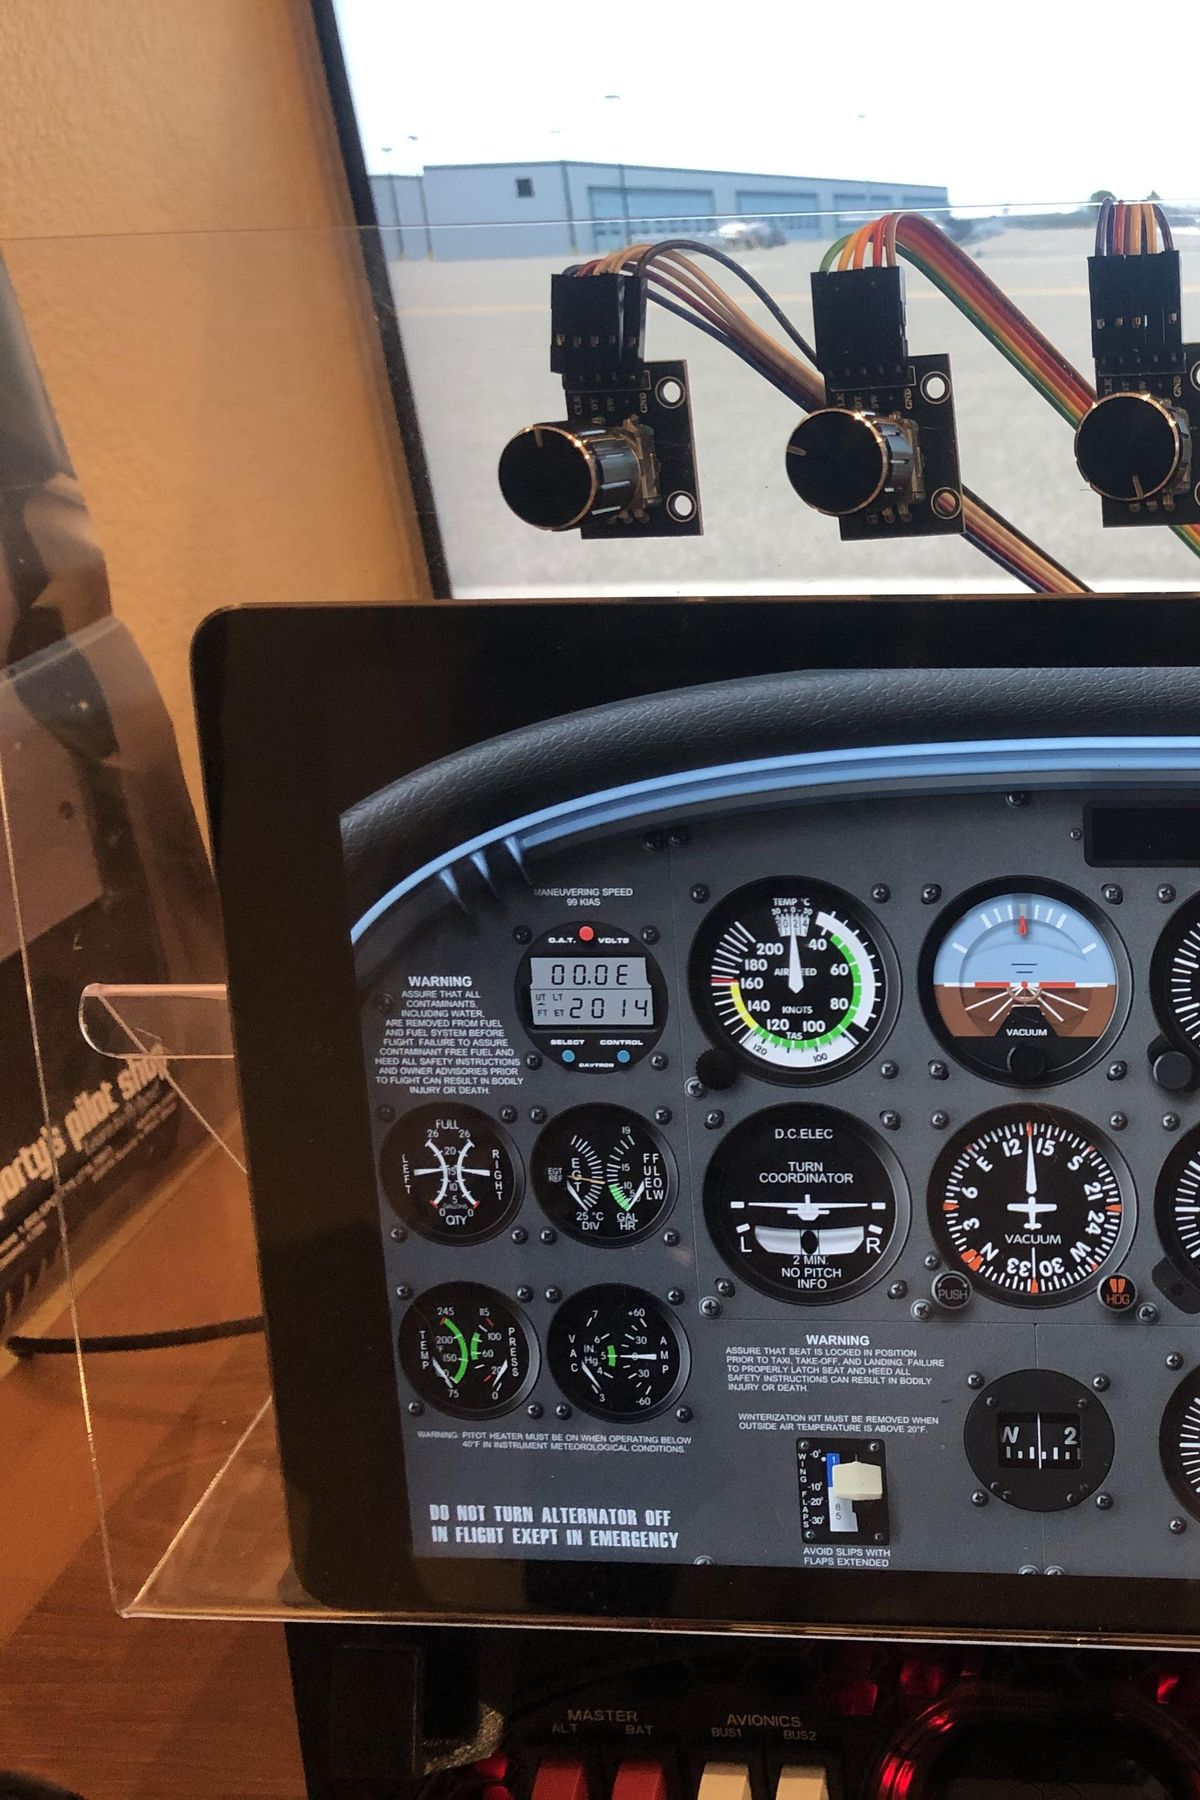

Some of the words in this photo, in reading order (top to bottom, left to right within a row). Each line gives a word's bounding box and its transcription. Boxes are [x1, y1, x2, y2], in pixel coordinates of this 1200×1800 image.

[534, 888, 599, 897] MANEUVERING
[602, 888, 633, 896] SPEED
[756, 943, 784, 955] 200
[808, 939, 827, 951] 40
[745, 959, 767, 971] 180
[830, 964, 848, 975] 60
[408, 976, 472, 987] WARNING
[741, 977, 763, 989] 160
[569, 998, 647, 1018] 2014
[748, 1000, 770, 1012] 140
[830, 998, 848, 1010] 80
[782, 1006, 813, 1014] KNOTS
[767, 1019, 789, 1030] 120
[803, 1020, 825, 1032] 100
[1006, 1029, 1047, 1037] VACUUM
[65, 1080, 120, 1153] pilot
[436, 1120, 459, 1129] FULL
[775, 1129, 833, 1139] D.C.ELEC
[1002, 1139, 1023, 1157] 12
[1036, 1138, 1056, 1156] 15
[788, 1162, 823, 1172] TURN
[759, 1173, 853, 1183] COORDINATOR
[446, 1215, 467, 1225] QTY
[617, 1212, 637, 1221] GAL
[582, 1221, 600, 1230] DIV
[620, 1222, 635, 1230] HR
[741, 1236, 752, 1252] L
[866, 1237, 881, 1253] R
[1005, 1234, 1061, 1245] VACUUM
[793, 1256, 800, 1265] 2
[782, 1268, 800, 1277] NO
[804, 1268, 841, 1277] PITCH
[797, 1279, 827, 1288] INFO
[938, 1290, 967, 1300] PUSH
[1105, 1295, 1129, 1305] HDG
[806, 1335, 870, 1346] WARNING
[908, 1359, 944, 1367] FAILURE
[738, 1413, 805, 1422] WINTERIZATION
[824, 1415, 848, 1423] MUST
[866, 1416, 910, 1424] REMOVED
[739, 1422, 777, 1431] OUTSIDE
[797, 1424, 861, 1432] TEMPERATURE
[875, 1425, 905, 1433] ABOVE
[430, 1504, 449, 1521] DO
[457, 1505, 485, 1522] NOT
[493, 1506, 533, 1523] TURN
[541, 1507, 637, 1525] ALTERNATOR
[645, 1510, 670, 1527] OFF
[432, 1526, 448, 1542] IN
[456, 1527, 504, 1544] FLIGHT
[512, 1528, 558, 1545] EXEPT
[567, 1529, 582, 1545] IN
[590, 1530, 678, 1548] EMERGENCY
[836, 1548, 863, 1556] SLIPS
[866, 1549, 890, 1557] WITH
[837, 1558, 889, 1567] EXTENDED
[568, 1710, 638, 1722] MASTER
[727, 1714, 801, 1727] AVIONICS
[552, 1723, 578, 1734] ALT
[625, 1725, 653, 1735] BAT
[712, 1727, 742, 1738] BUS1
[783, 1730, 816, 1741] BUS2
